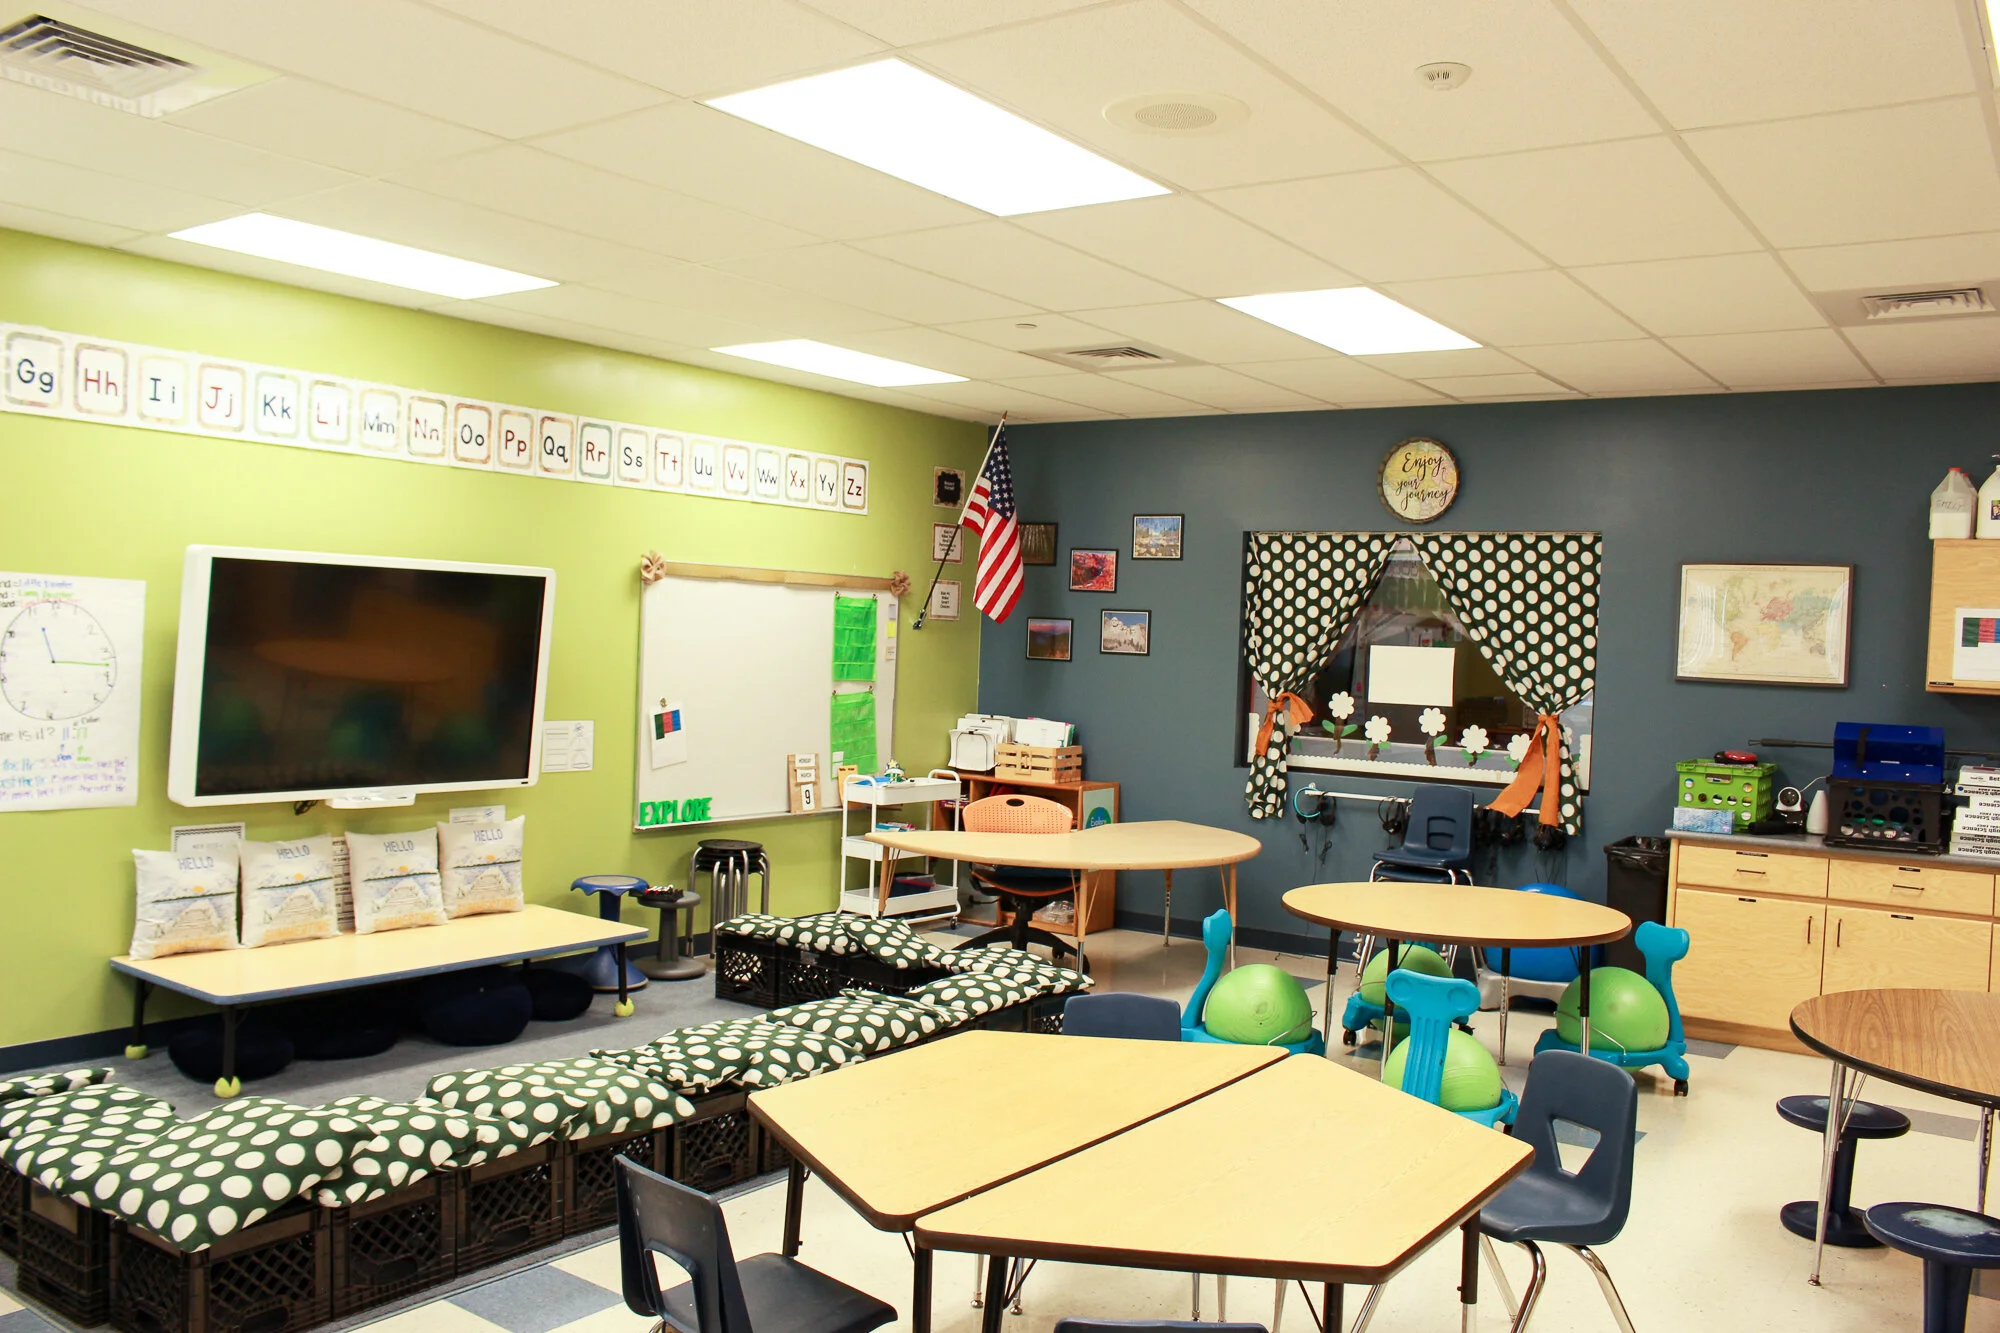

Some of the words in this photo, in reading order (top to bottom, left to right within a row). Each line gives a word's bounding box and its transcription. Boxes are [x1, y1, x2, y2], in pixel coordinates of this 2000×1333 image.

[16, 359, 54, 393] Gg
[84, 368, 118, 397] Hh
[263, 394, 292, 420] Kk
[363, 412, 395, 435] Mm
[415, 418, 440, 442] Nn
[460, 424, 485, 447] Oo
[505, 430, 527, 457] Pp
[543, 435, 568, 463] Qq
[585, 441, 606, 463] Rr
[623, 446, 643, 468] Ss
[660, 451, 678, 473] Tt
[694, 456, 713, 477] Uu
[727, 462, 744, 481] Vv
[1402, 452, 1445, 481] Enjoy
[757, 468, 778, 486] Ww
[790, 470, 806, 489] Xx
[819, 474, 835, 496] Yy
[847, 478, 862, 497] Zz
[1396, 478, 1420, 496] your
[1400, 488, 1451, 511] journey
[804, 789, 810, 804] 9
[639, 797, 712, 826] EXPLORE
[473, 828, 503, 842] HELLO
[1960, 835, 1985, 843] Science
[1962, 825, 1987, 833] Science
[277, 845, 310, 859] HELLO
[383, 840, 414, 852] HELLO
[177, 856, 214, 870] HELLO
